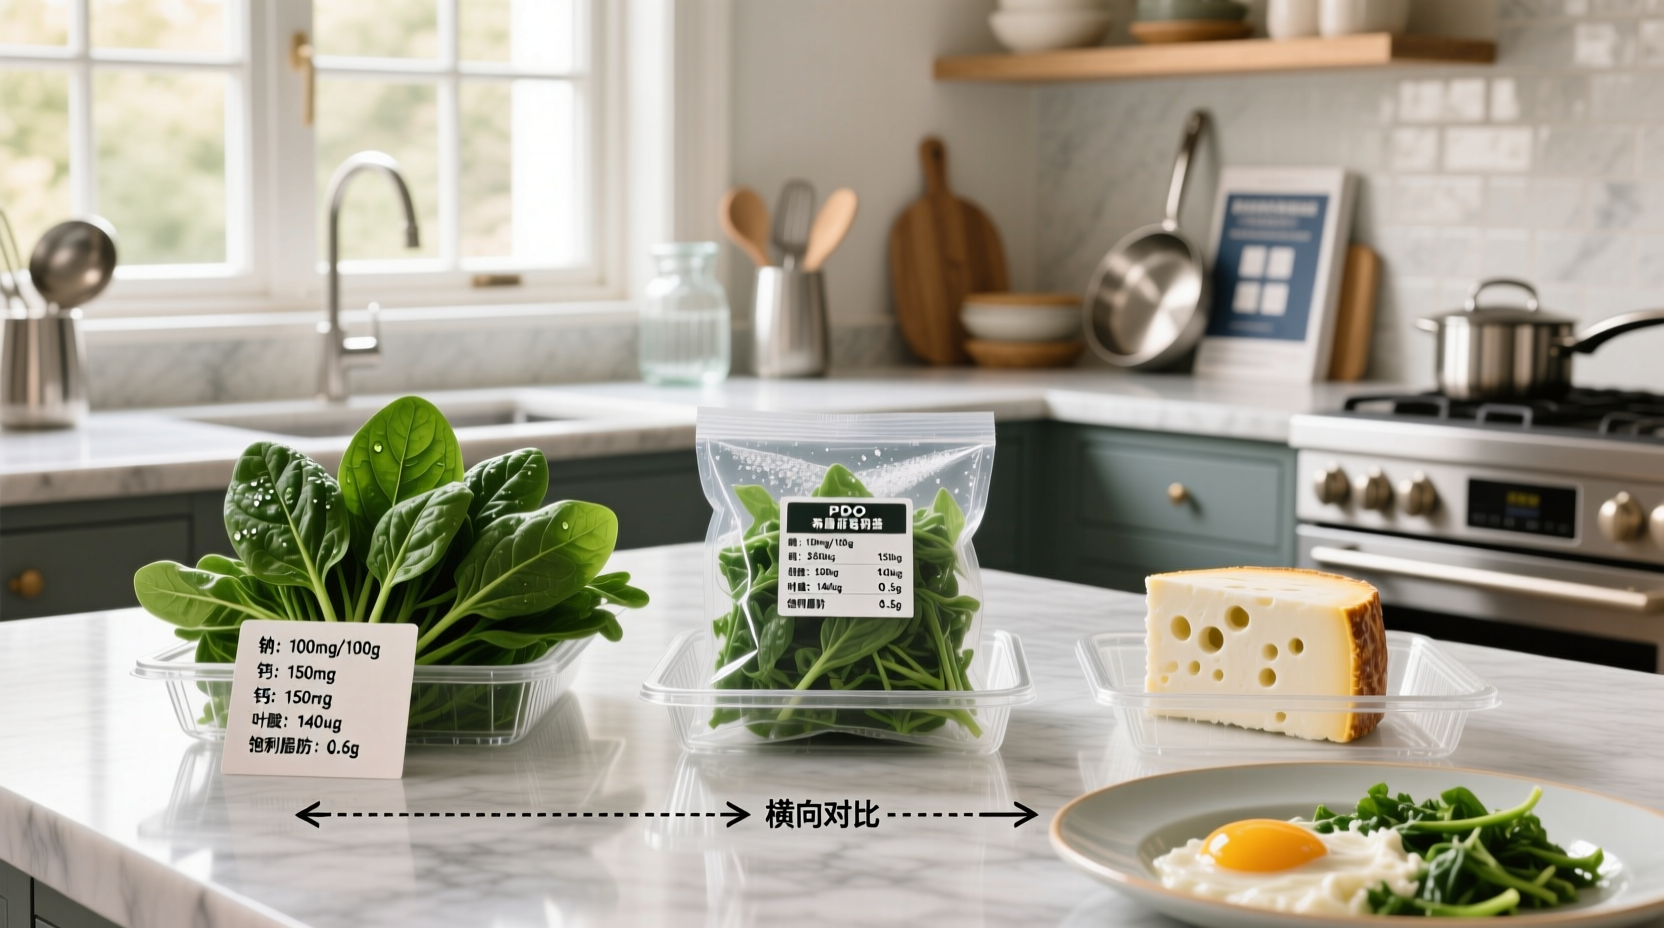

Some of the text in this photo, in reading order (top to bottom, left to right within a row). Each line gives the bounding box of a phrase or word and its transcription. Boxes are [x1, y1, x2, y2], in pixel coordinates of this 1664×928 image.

[828, 504, 866, 517] PDO
[289, 638, 380, 660] 100mg/100g
[287, 664, 336, 684] 150mg
[297, 714, 342, 733] 140ug
[326, 738, 359, 758] 0.6g
